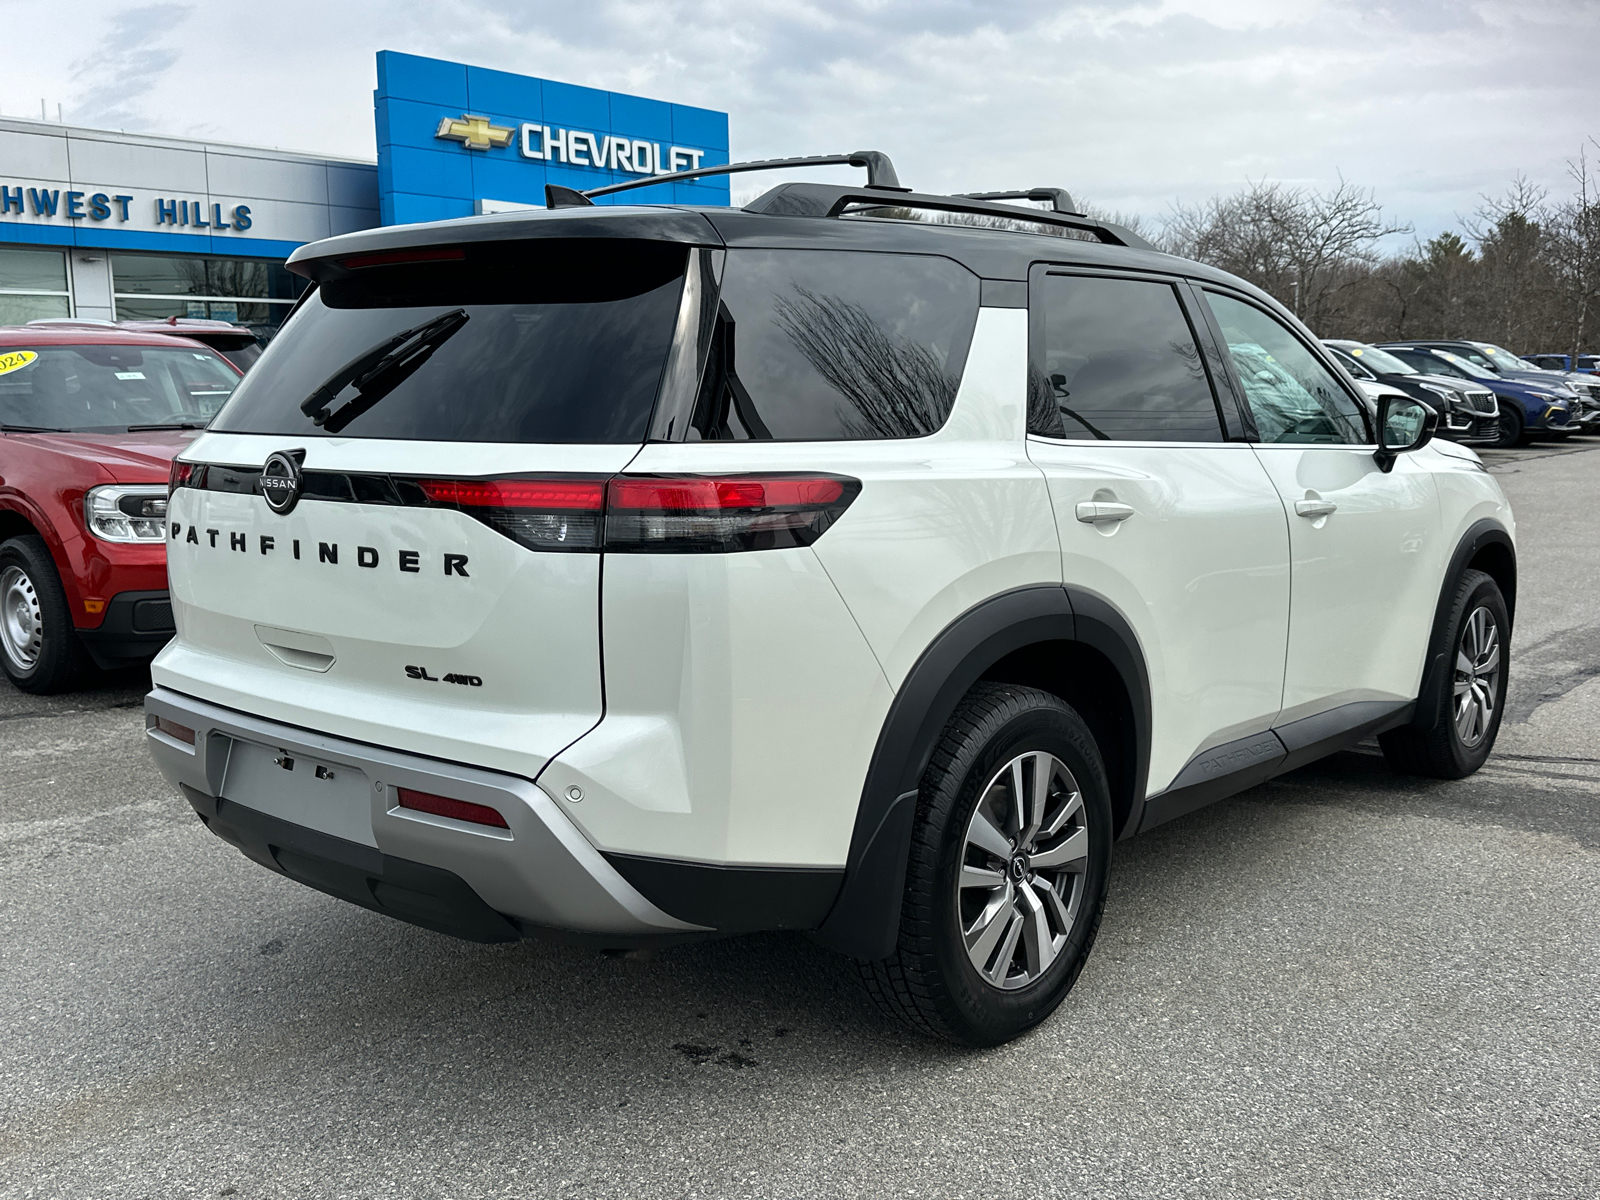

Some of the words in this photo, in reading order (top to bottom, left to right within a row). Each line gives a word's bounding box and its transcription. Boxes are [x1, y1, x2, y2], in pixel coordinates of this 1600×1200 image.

[520, 122, 704, 181] CHEVROLET
[1, 185, 133, 221] HWEST
[155, 198, 252, 230] HILLS
[259, 478, 296, 489] NISSAN
[171, 521, 470, 577] PATHFINDER
[404, 664, 438, 682] SL
[442, 672, 483, 687] 4WD
[1199, 738, 1281, 774] PATHFINDER
